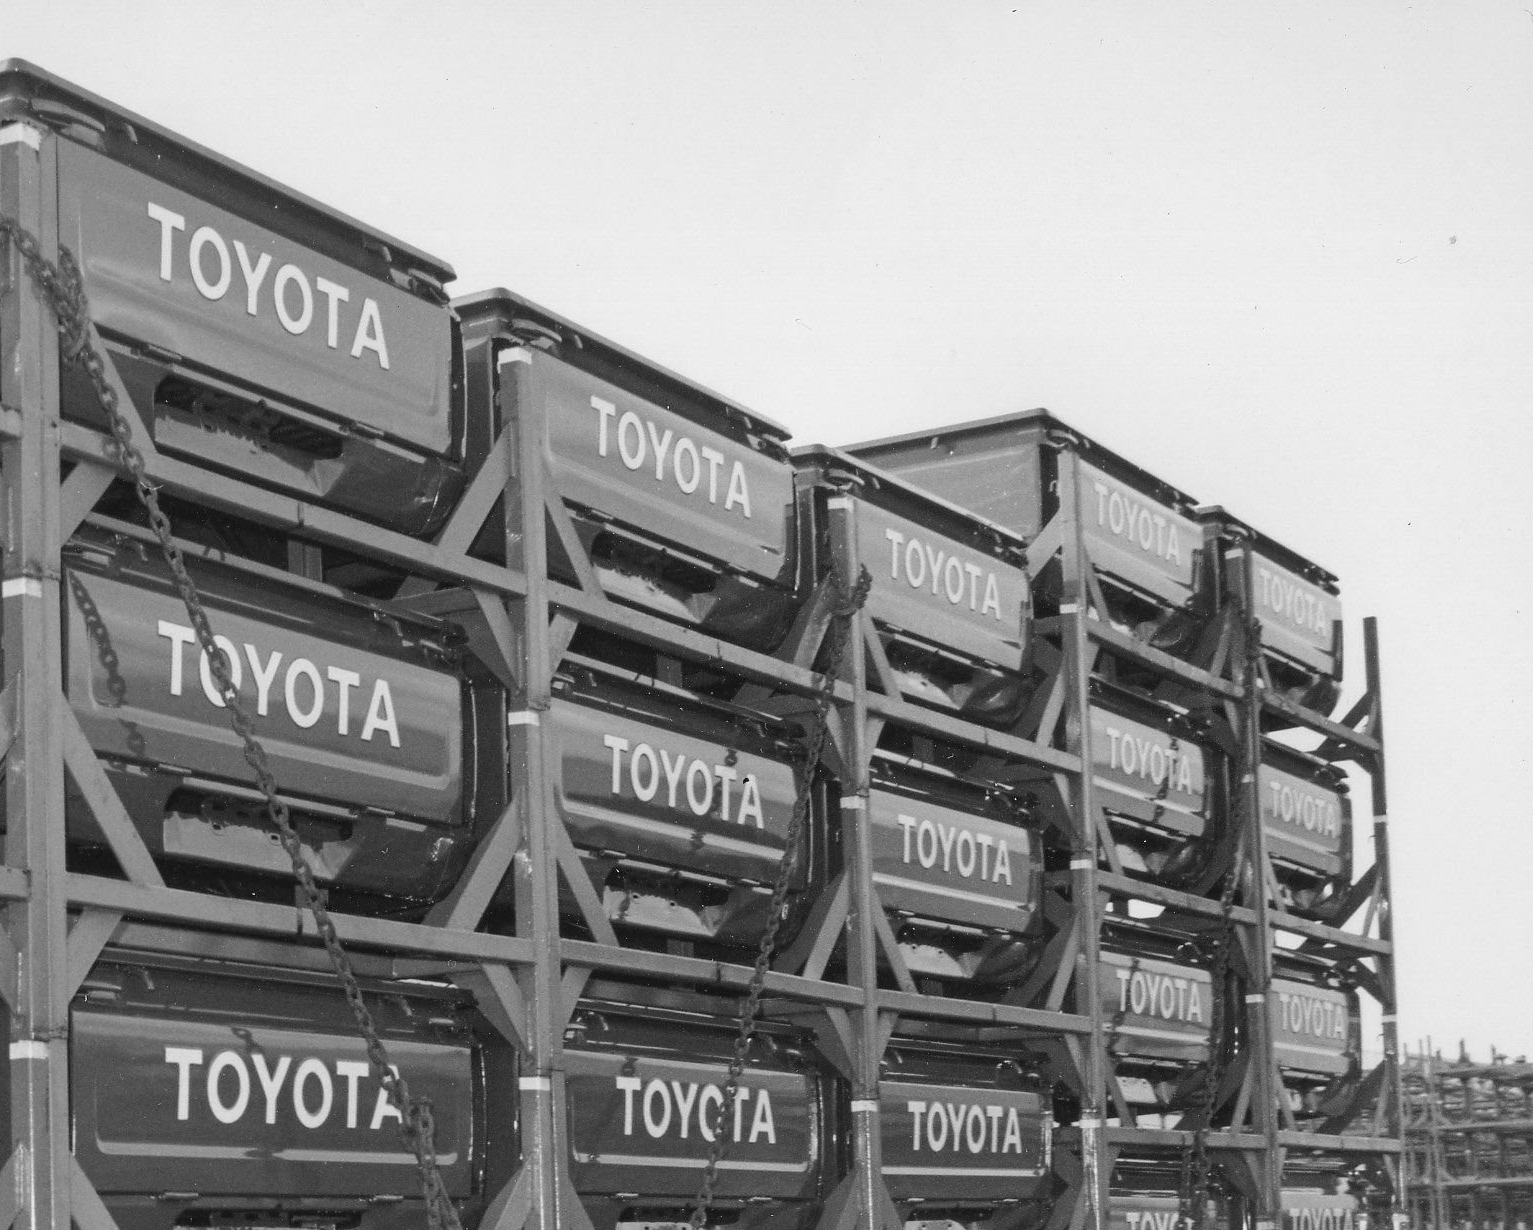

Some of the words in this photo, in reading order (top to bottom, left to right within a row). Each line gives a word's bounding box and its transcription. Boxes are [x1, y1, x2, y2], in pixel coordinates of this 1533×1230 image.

[148, 202, 390, 370] TOYOTA
[590, 395, 752, 519] TOYOTA
[1094, 482, 1180, 566] TOYOTA
[886, 528, 1001, 620] TOYOTA
[1260, 568, 1326, 636] TOYOTA
[158, 620, 400, 748] TOYOTA
[604, 733, 764, 829] TOYOTA
[1106, 727, 1192, 795] TOYOTA
[1269, 781, 1337, 838] TOYOTA
[898, 814, 1012, 886] TOYOTA
[1116, 969, 1202, 1022] TOYOTA
[1279, 993, 1345, 1040] TOYOTA
[165, 1047, 403, 1130] TOYOTA
[616, 1076, 776, 1144] TOYOTA
[908, 1101, 1022, 1154] TOYOTA
